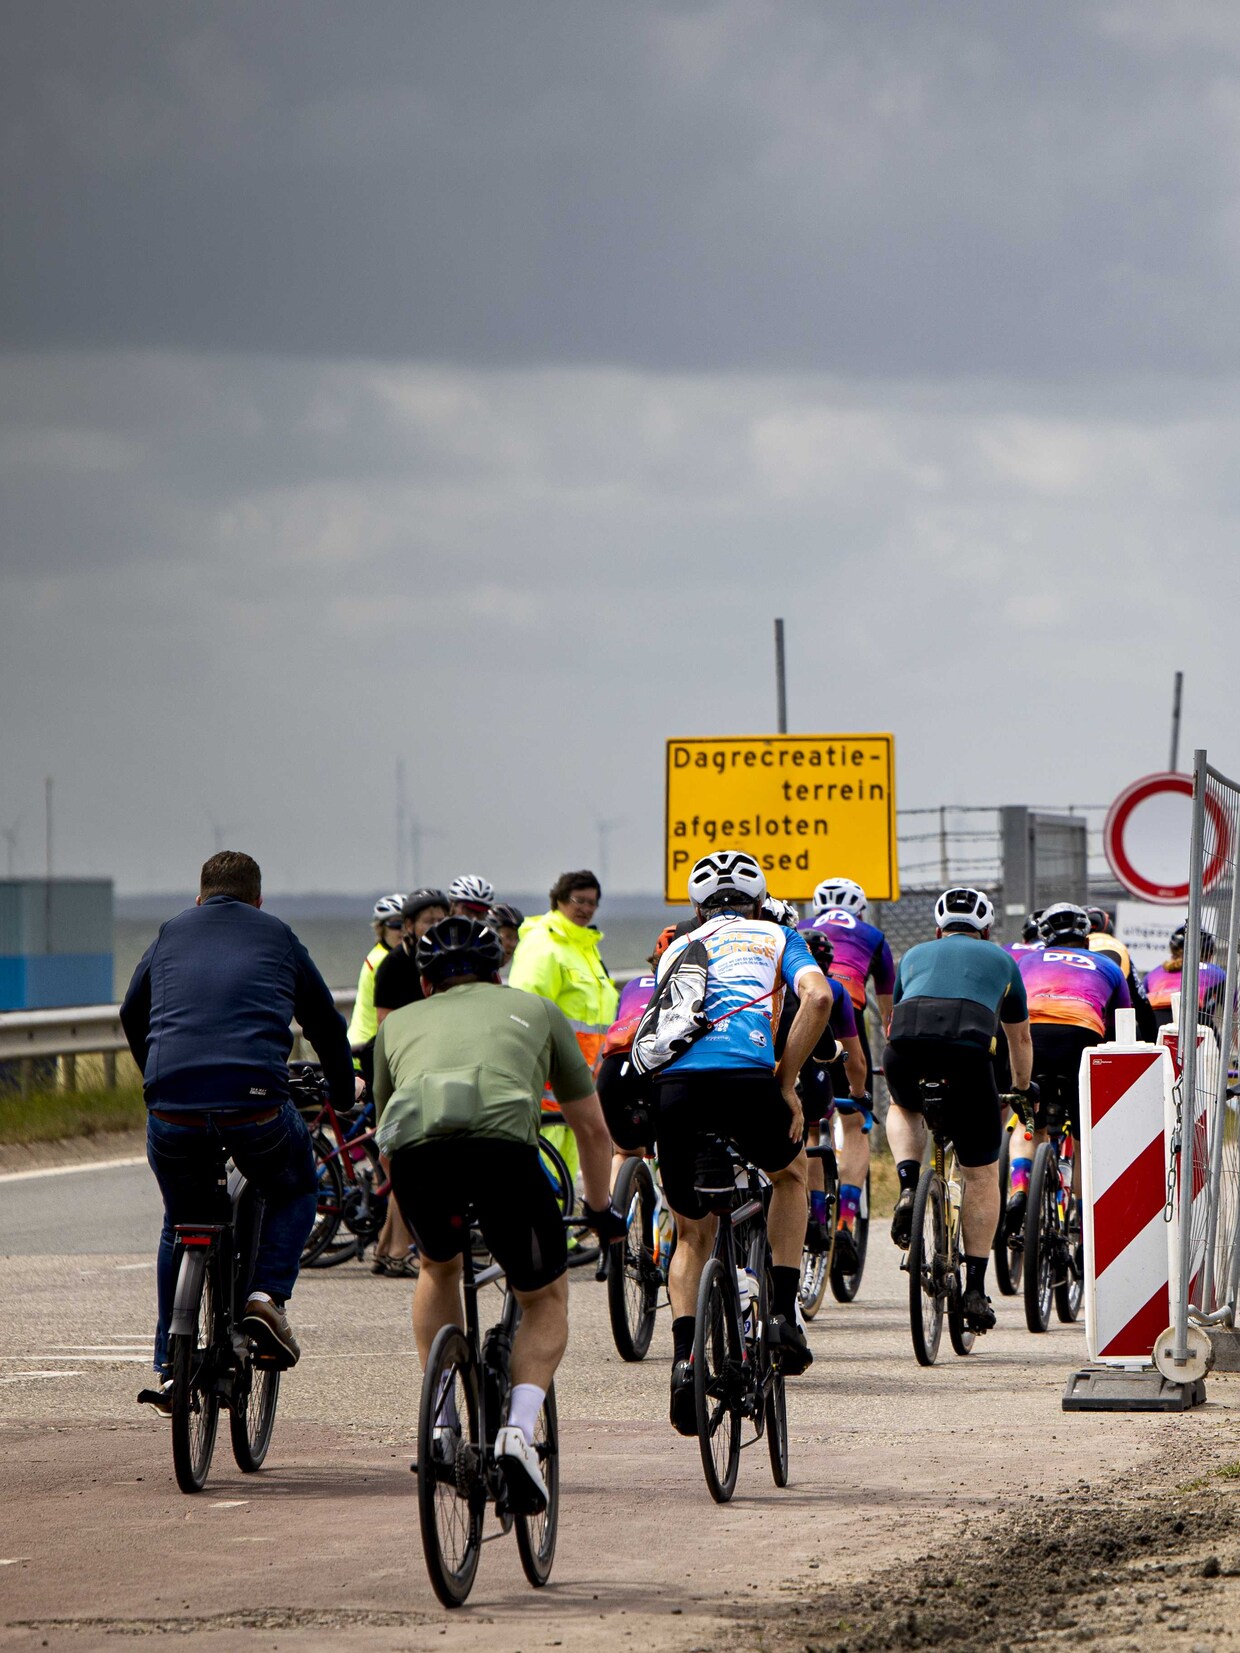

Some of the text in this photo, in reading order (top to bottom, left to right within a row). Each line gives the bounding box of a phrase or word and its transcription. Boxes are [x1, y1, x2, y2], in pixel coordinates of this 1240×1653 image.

[674, 746, 880, 774] Dagrecreatie-
[781, 779, 884, 801] terrein
[673, 815, 829, 843] afgesloten
